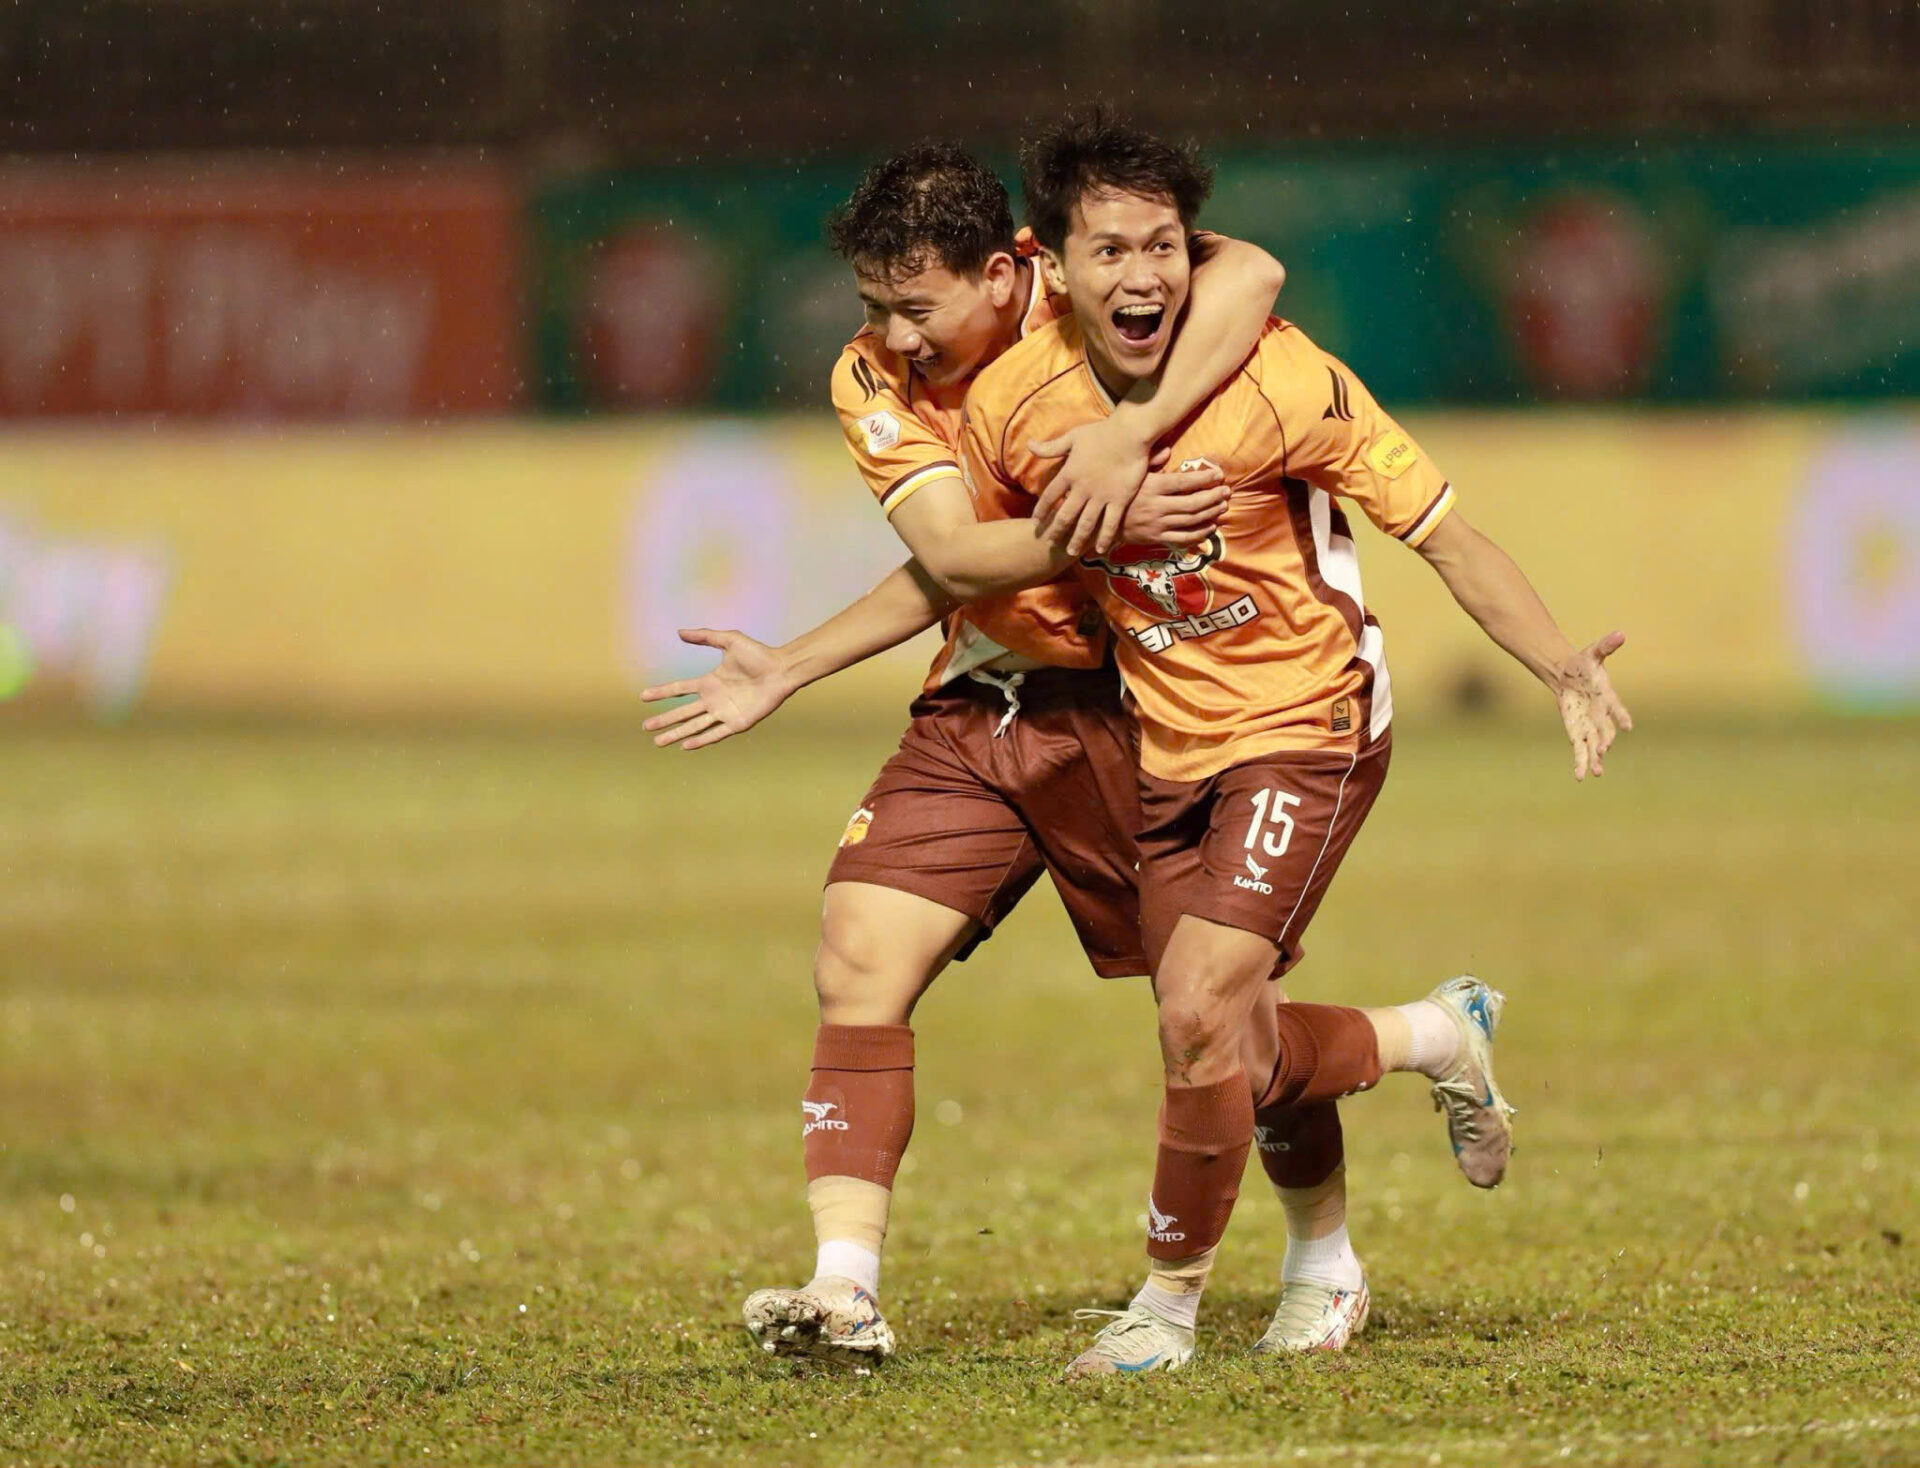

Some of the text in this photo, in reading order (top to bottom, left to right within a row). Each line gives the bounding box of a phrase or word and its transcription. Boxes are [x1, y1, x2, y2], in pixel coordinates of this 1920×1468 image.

[1126, 594, 1260, 654] arabao
[1243, 787, 1301, 857] 15
[1233, 875, 1273, 895] KAMITO
[802, 1119, 849, 1138] AMITO
